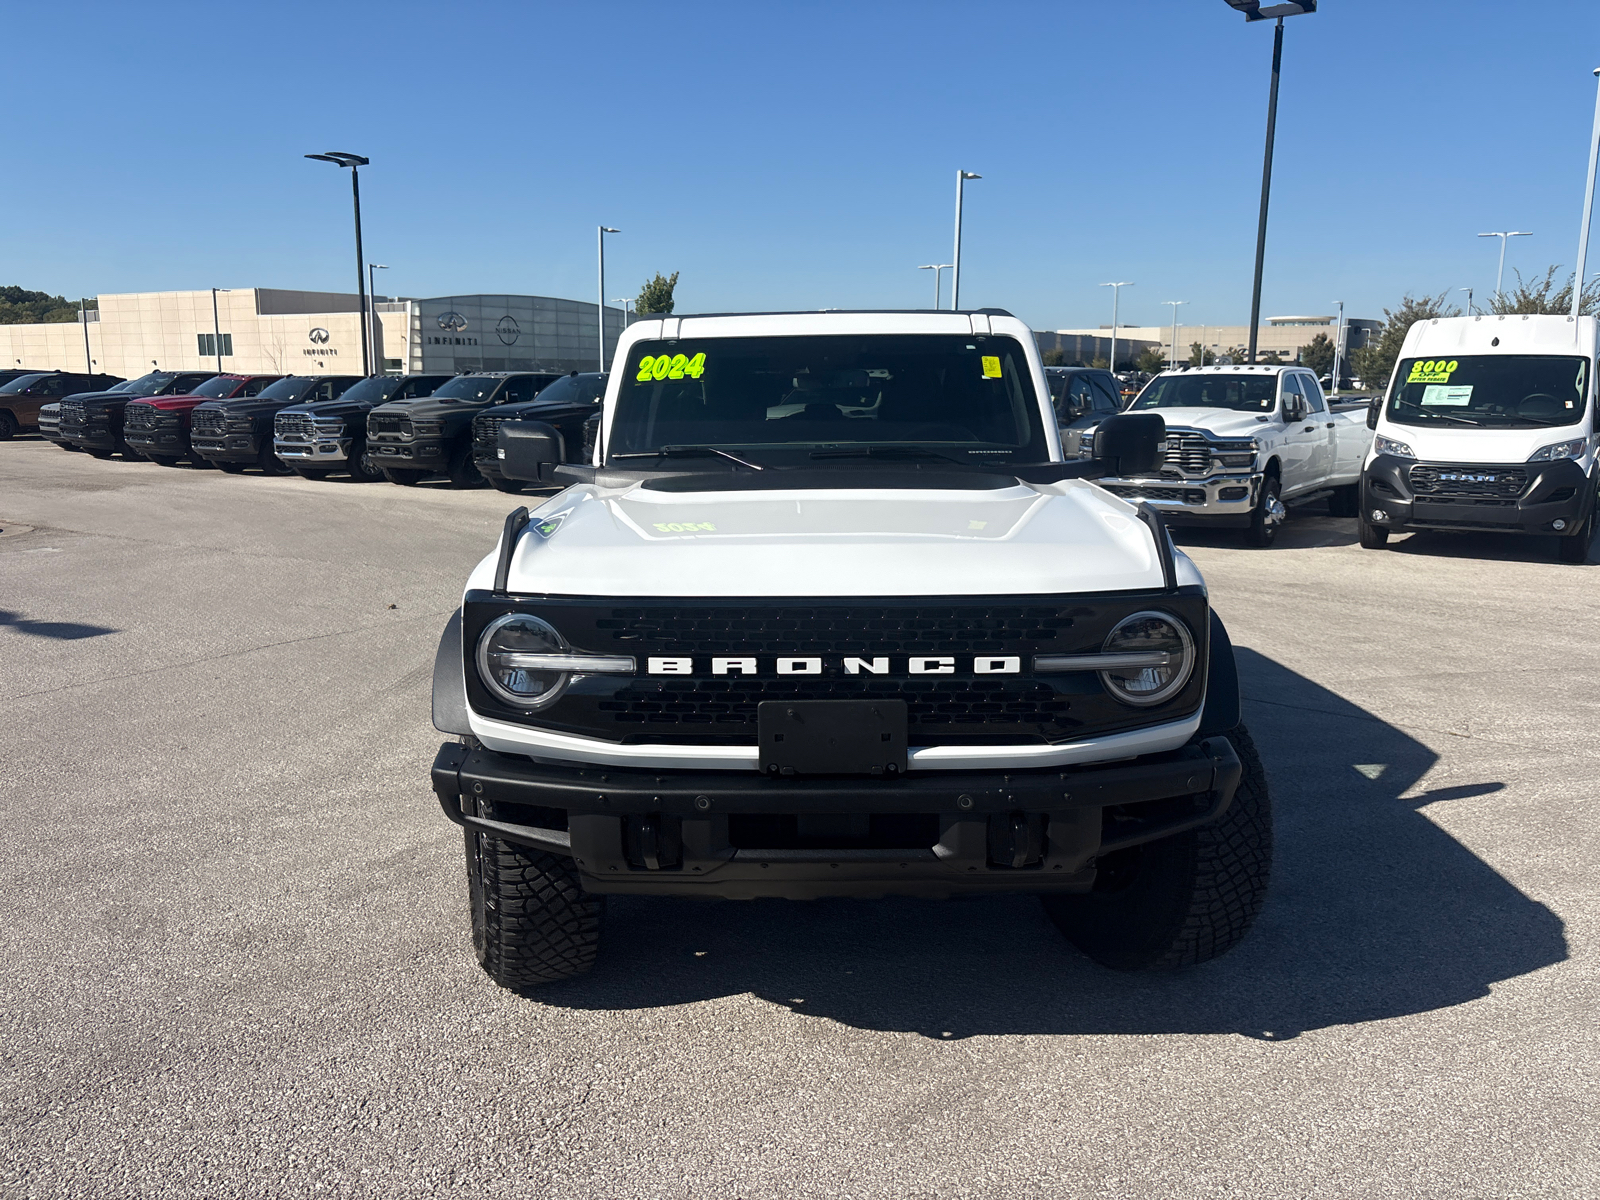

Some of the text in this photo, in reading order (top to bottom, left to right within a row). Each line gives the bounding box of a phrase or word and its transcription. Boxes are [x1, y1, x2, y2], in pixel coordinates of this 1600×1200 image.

[428, 337, 478, 346] INFINITI
[636, 353, 706, 381] 2024
[1411, 360, 1459, 373] 8000
[1440, 474, 1495, 482] RAM
[648, 656, 1021, 674] BRONCO
